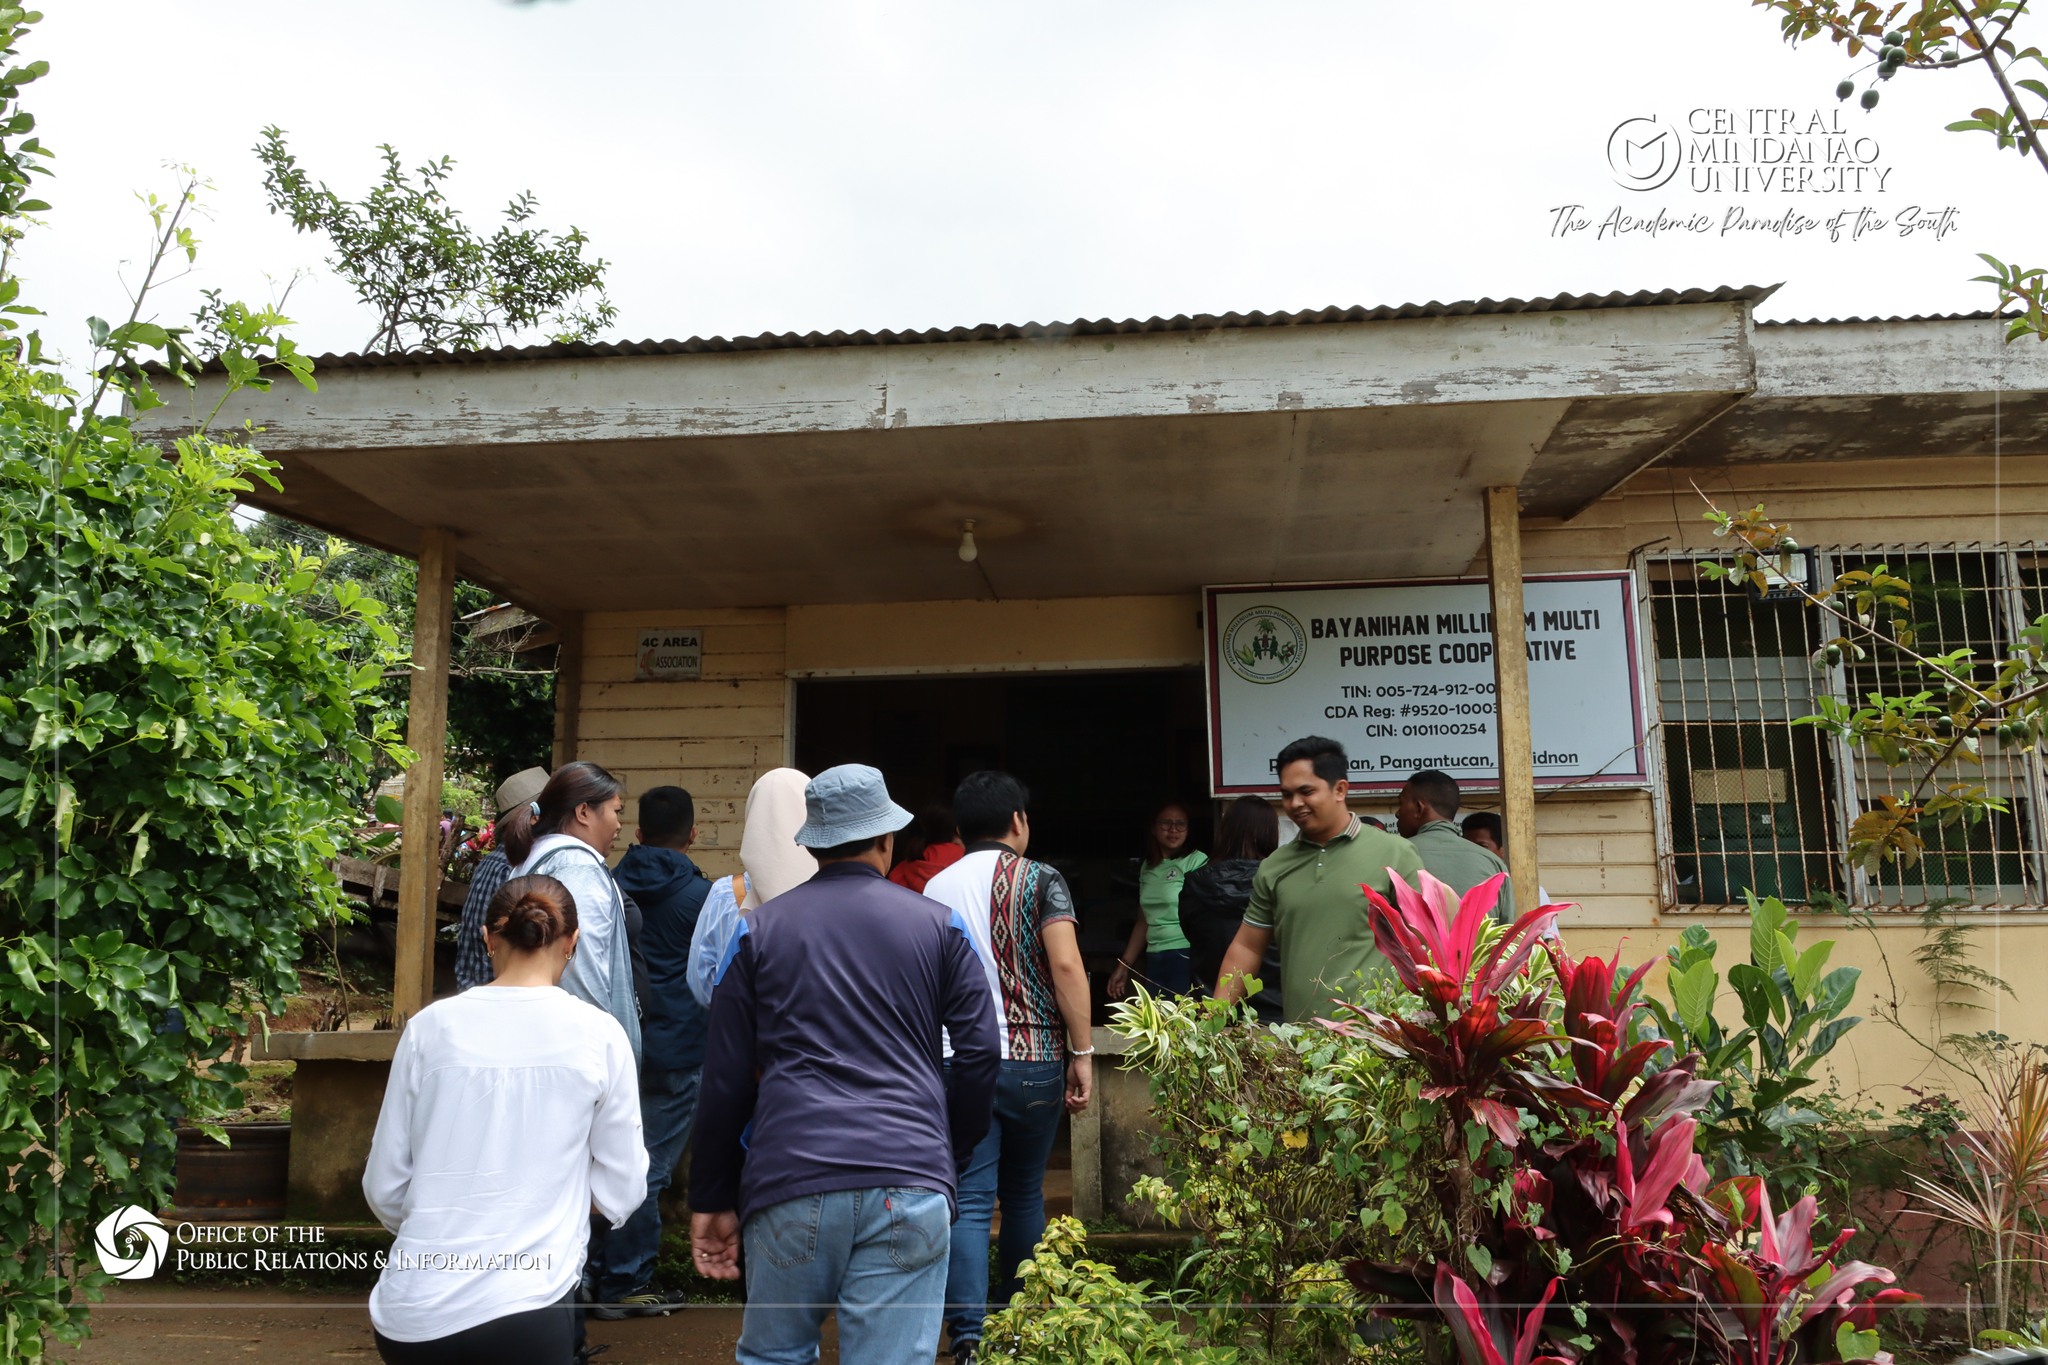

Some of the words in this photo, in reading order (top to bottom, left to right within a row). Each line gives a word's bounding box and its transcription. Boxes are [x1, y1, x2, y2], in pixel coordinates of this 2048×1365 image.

[1310, 614, 1430, 639] BAYANIHAN
[1542, 609, 1600, 631] MULTI
[642, 637, 659, 648] 4C
[663, 637, 698, 648] AREA
[1339, 644, 1432, 667] PURPOSE
[1438, 640, 1577, 664] COOPATIVE
[656, 656, 698, 669] ASSOCIATION
[1341, 685, 1372, 699] TIN:
[1376, 681, 1496, 698] 005-724-912-00
[1324, 705, 1359, 719] CDA
[1363, 704, 1395, 720] Reg:
[1365, 724, 1398, 738] CIN:
[1402, 722, 1487, 737] 0101100254
[1379, 752, 1496, 771] Pangantucan,
